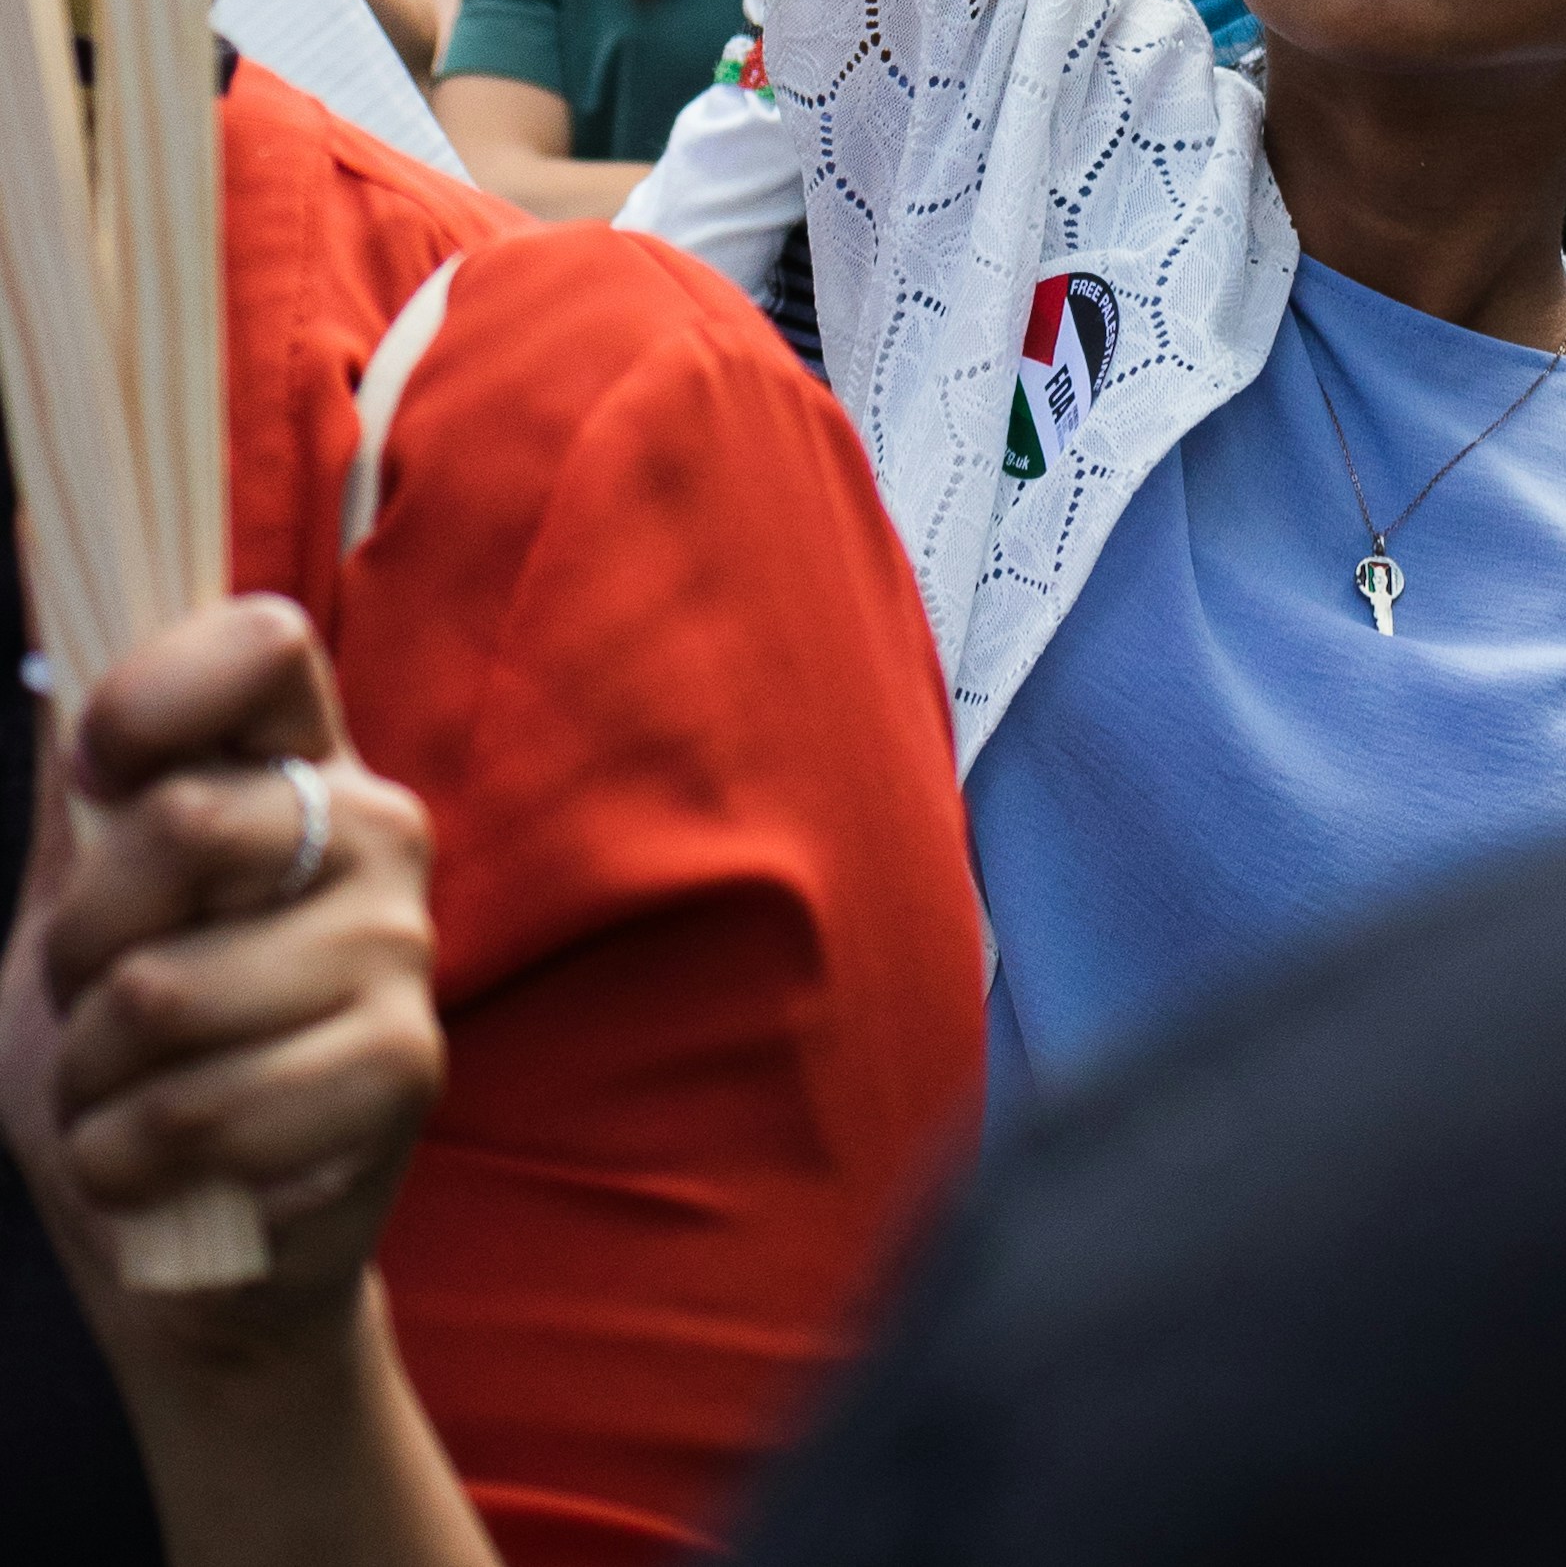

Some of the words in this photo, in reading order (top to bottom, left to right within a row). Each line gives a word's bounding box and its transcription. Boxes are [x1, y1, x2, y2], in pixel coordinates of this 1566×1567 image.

[1069, 278, 1102, 304] FREE
[1093, 295, 1118, 392] PALESTINE
[1044, 363, 1079, 426] FOA
